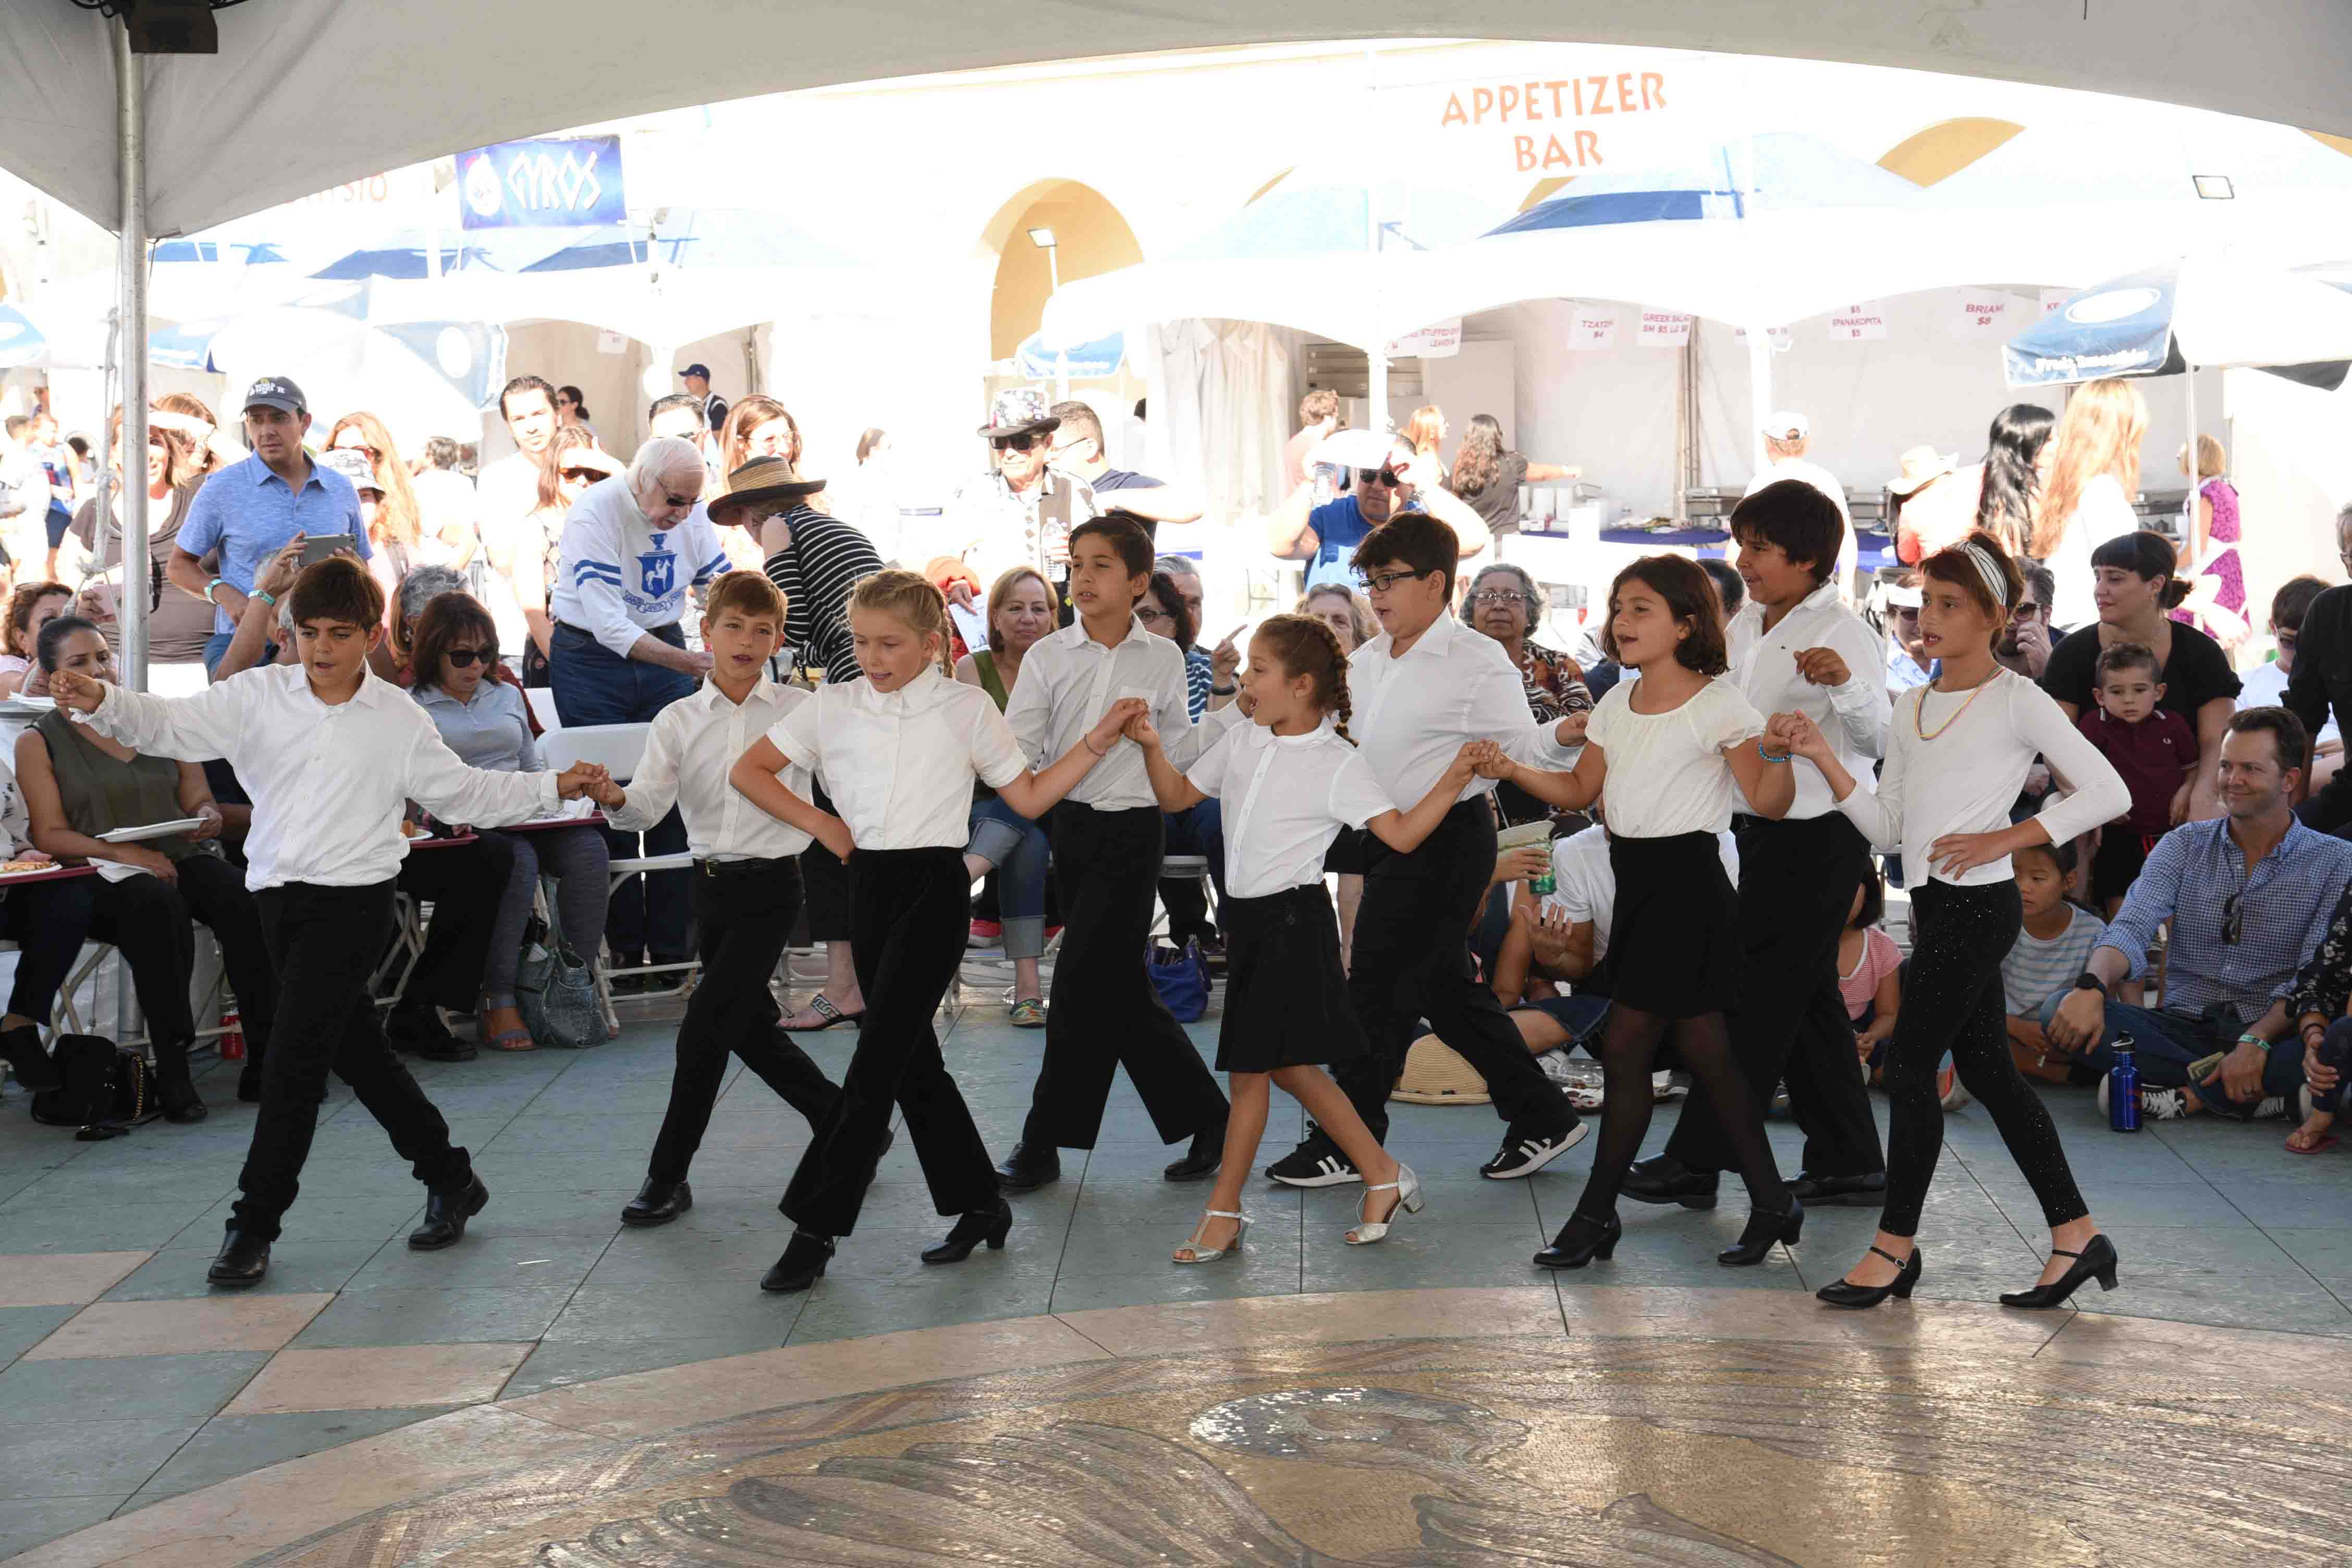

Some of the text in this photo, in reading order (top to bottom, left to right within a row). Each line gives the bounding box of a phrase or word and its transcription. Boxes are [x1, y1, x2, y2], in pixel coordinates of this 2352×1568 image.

[1441, 72, 1668, 127] APPETIZER
[1514, 129, 1603, 172] BAR
[507, 150, 602, 211] GYROS
